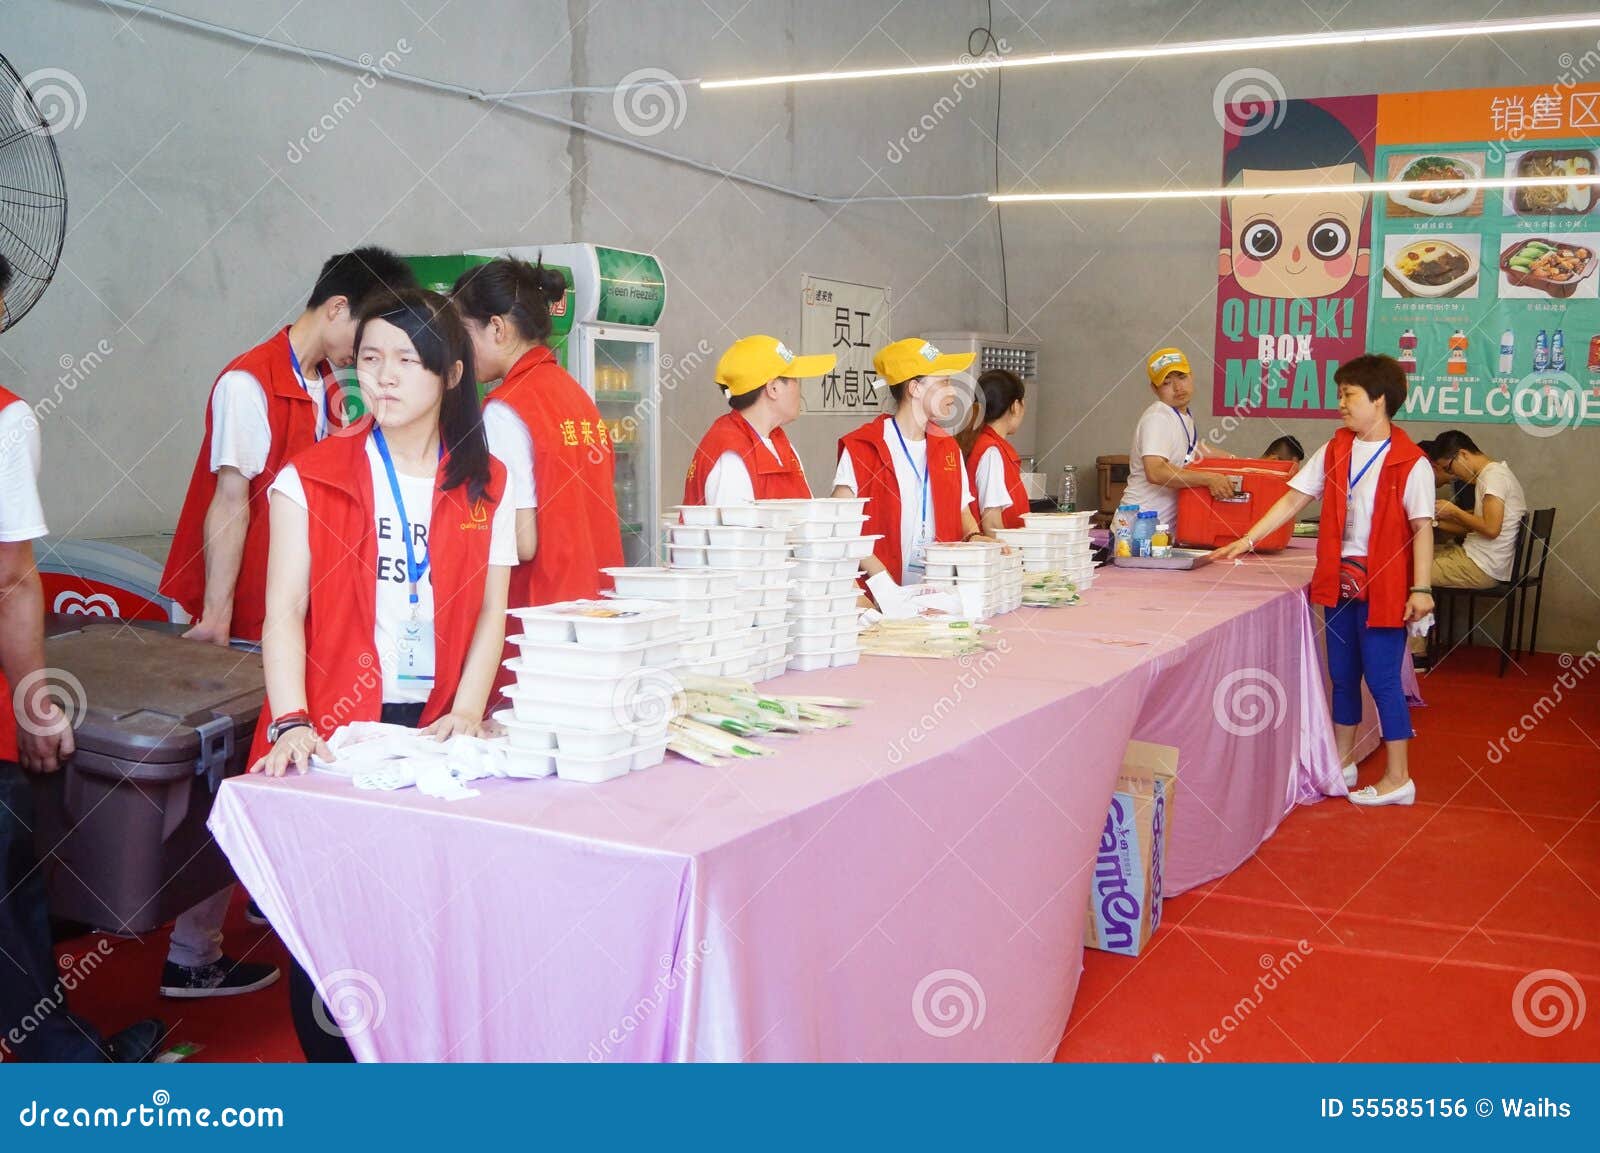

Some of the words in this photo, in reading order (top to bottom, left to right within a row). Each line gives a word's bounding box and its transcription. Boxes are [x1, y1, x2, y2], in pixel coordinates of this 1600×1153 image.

[1490, 93, 1600, 131] 销售区
[833, 307, 871, 348] 员工
[1222, 297, 1355, 342] QUICK!
[1258, 334, 1312, 362] BOX
[821, 366, 879, 408] 休息区
[1404, 386, 1600, 419] WELCOME
